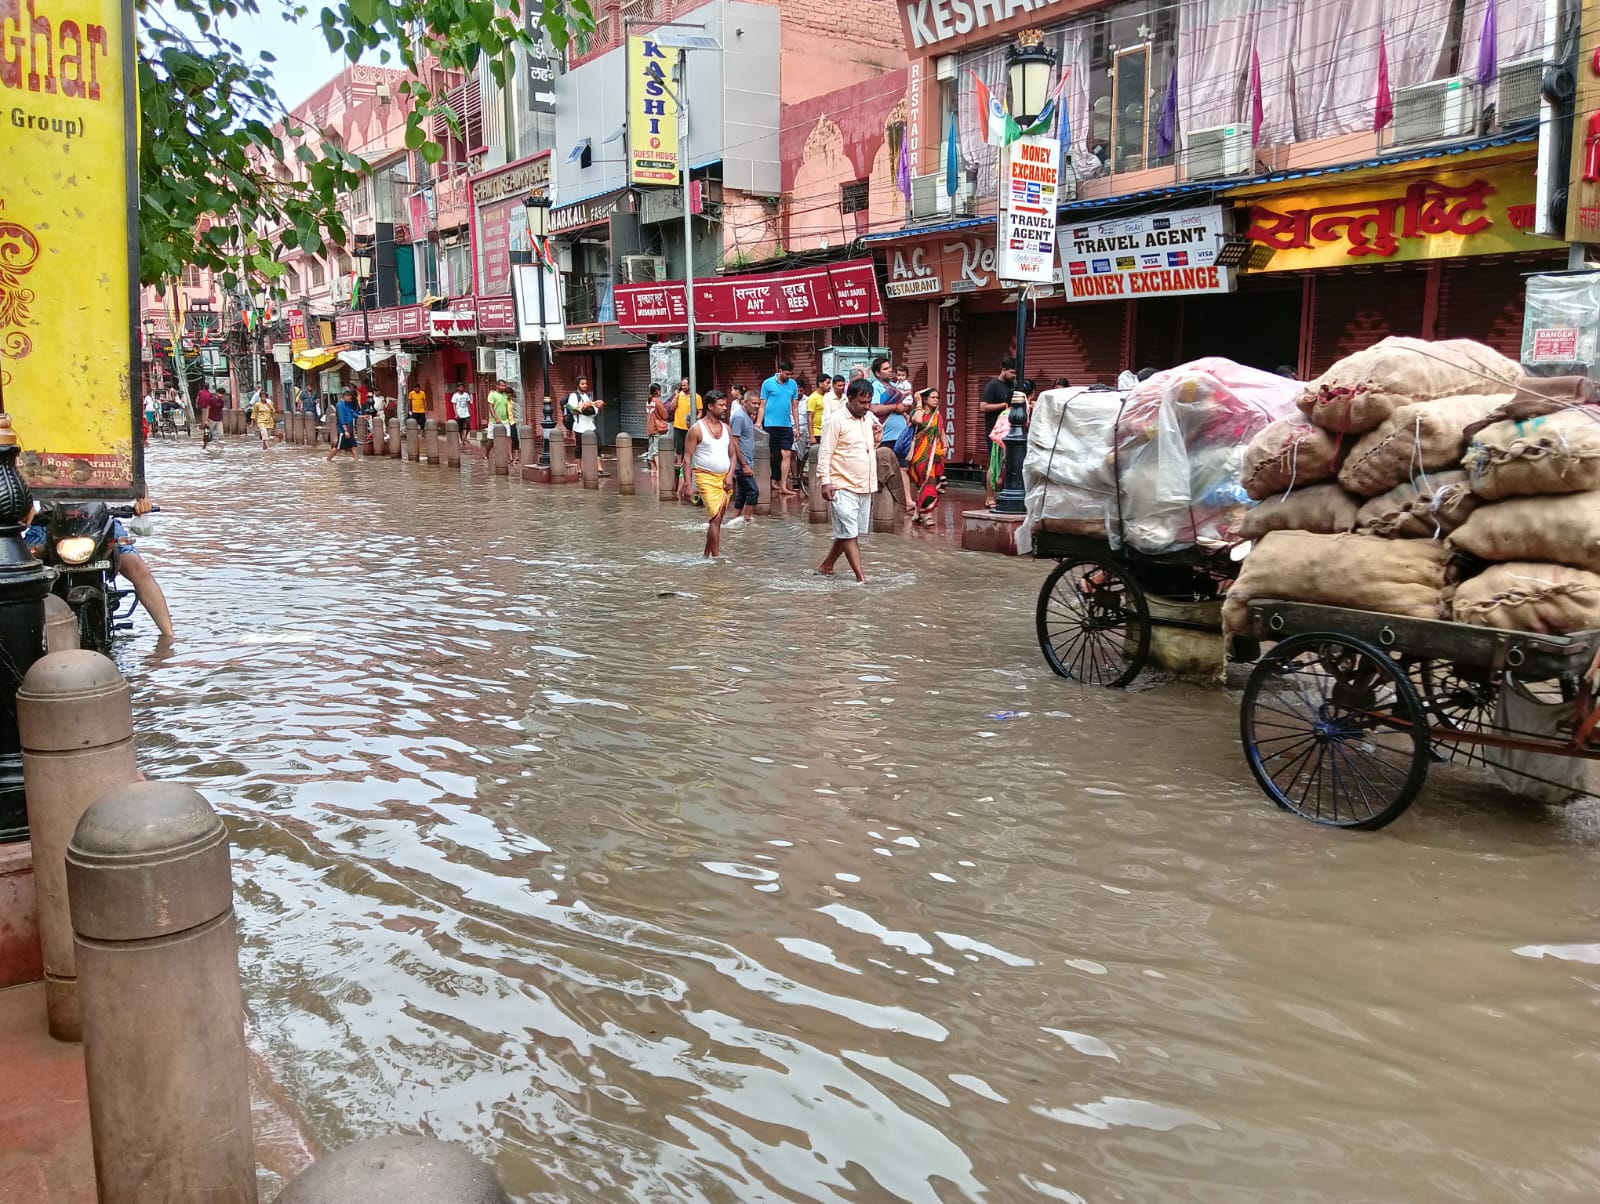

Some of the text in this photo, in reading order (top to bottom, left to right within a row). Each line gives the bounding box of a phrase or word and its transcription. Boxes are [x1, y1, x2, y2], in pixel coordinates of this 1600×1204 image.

[643, 41, 666, 134] KASHI
[11, 107, 84, 138] Group)
[911, 64, 920, 195] RESTAURA
[633, 150, 678, 161] GUEST HOUSE
[1021, 144, 1051, 164] MONEY
[1012, 162, 1057, 184] EXCHANGE
[1010, 213, 1054, 229] TRAVEL
[1245, 180, 1497, 256] सन्तुष्टि
[1013, 227, 1050, 242] AGENT
[1074, 235, 1139, 254] TRAVEL
[1145, 227, 1206, 247] AGENT
[893, 238, 996, 286] A.C. Ke
[887, 279, 937, 296] RESTAURANT
[1070, 274, 1124, 297] MONEY
[1128, 266, 1220, 293] EXCHANGE
[747, 296, 809, 310] ANT REES
[946, 324, 957, 460] RESTAURANT
[47, 457, 72, 468] Roa
